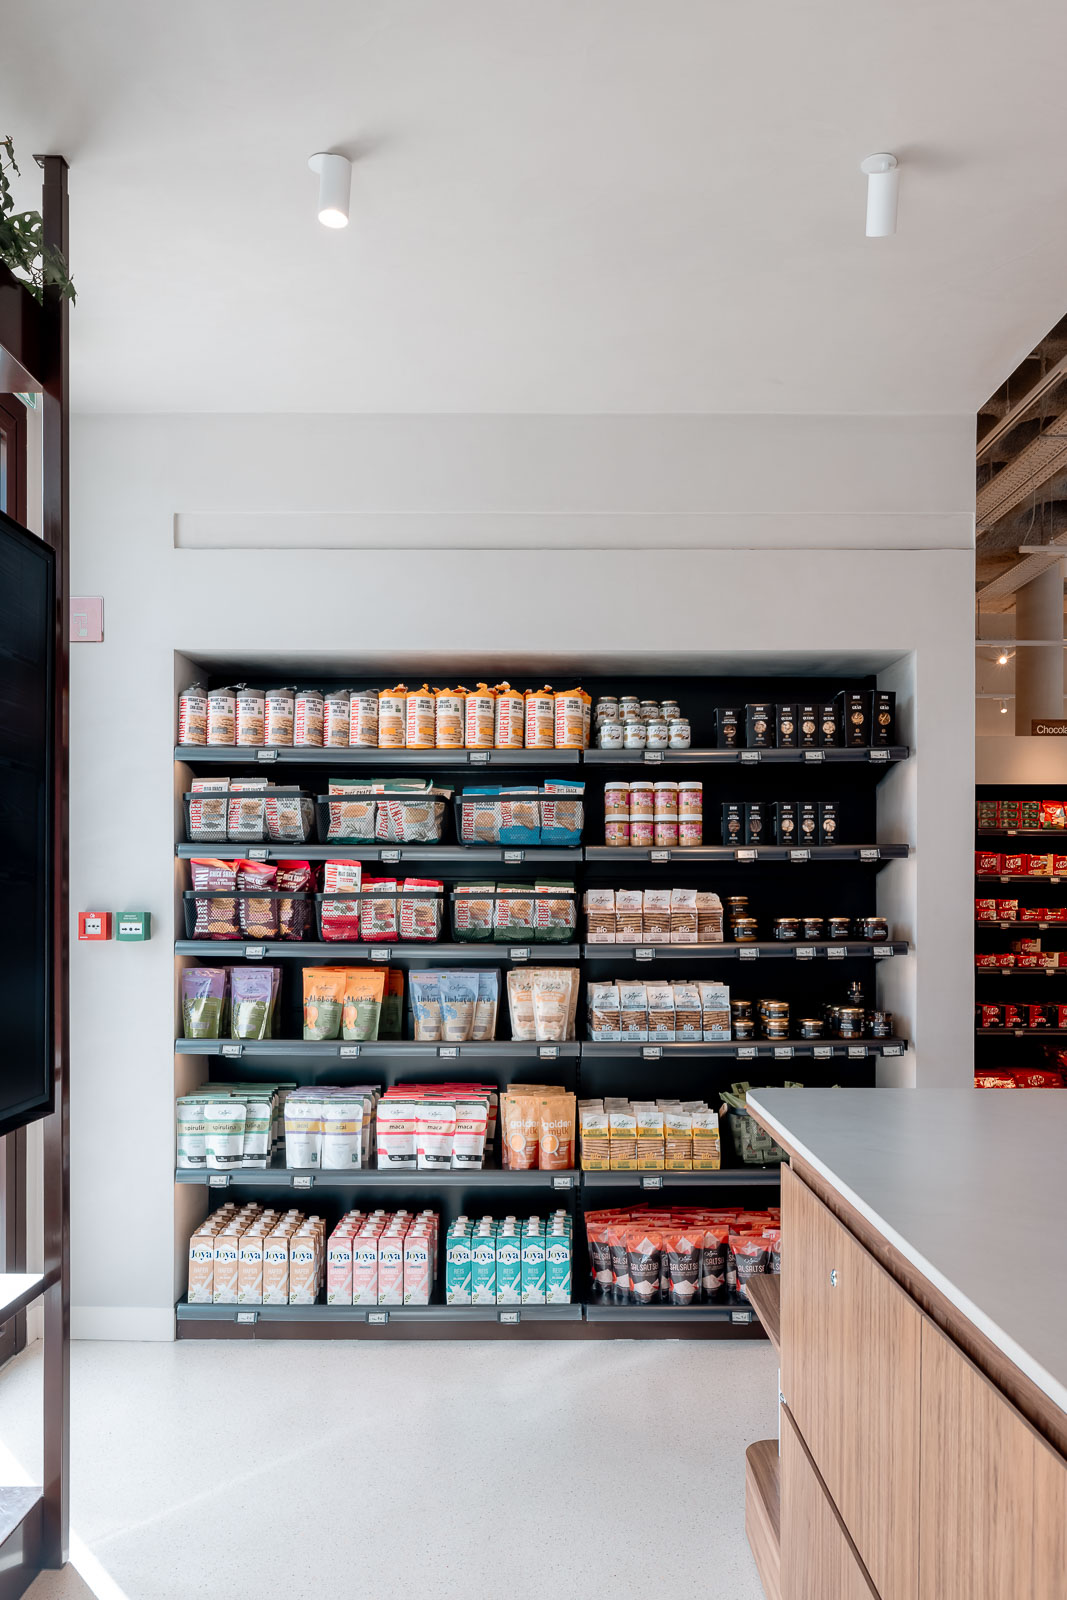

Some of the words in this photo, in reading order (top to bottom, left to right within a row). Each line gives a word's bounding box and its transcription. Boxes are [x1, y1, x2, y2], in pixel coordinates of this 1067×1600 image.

[350, 699, 360, 744] FIORENTINI
[407, 699, 417, 744] FIORENTINI
[467, 699, 477, 744] FIORENTINI
[498, 700, 510, 744] FIORENTINI
[527, 700, 537, 745] FIORENTINI
[556, 699, 566, 744] FIORENTINI
[543, 1119, 572, 1131] golden
[548, 1127, 569, 1136] mylk
[191, 1250, 212, 1260] Joya
[215, 1250, 236, 1260] Joya
[240, 1251, 261, 1261] Joya
[265, 1251, 286, 1262] Joya
[292, 1251, 313, 1262] Joya
[329, 1251, 350, 1262] Joya
[355, 1251, 376, 1262] Joya
[380, 1251, 400, 1262] Joya
[406, 1251, 426, 1262] Joya
[449, 1251, 469, 1262] Joya
[473, 1251, 494, 1262] Joya
[498, 1251, 519, 1262] Joya
[523, 1251, 544, 1261] Joya
[547, 1250, 568, 1261] Joya
[640, 1263, 652, 1271] SALT
[670, 1263, 680, 1271] SAL
[680, 1263, 692, 1271] SALT
